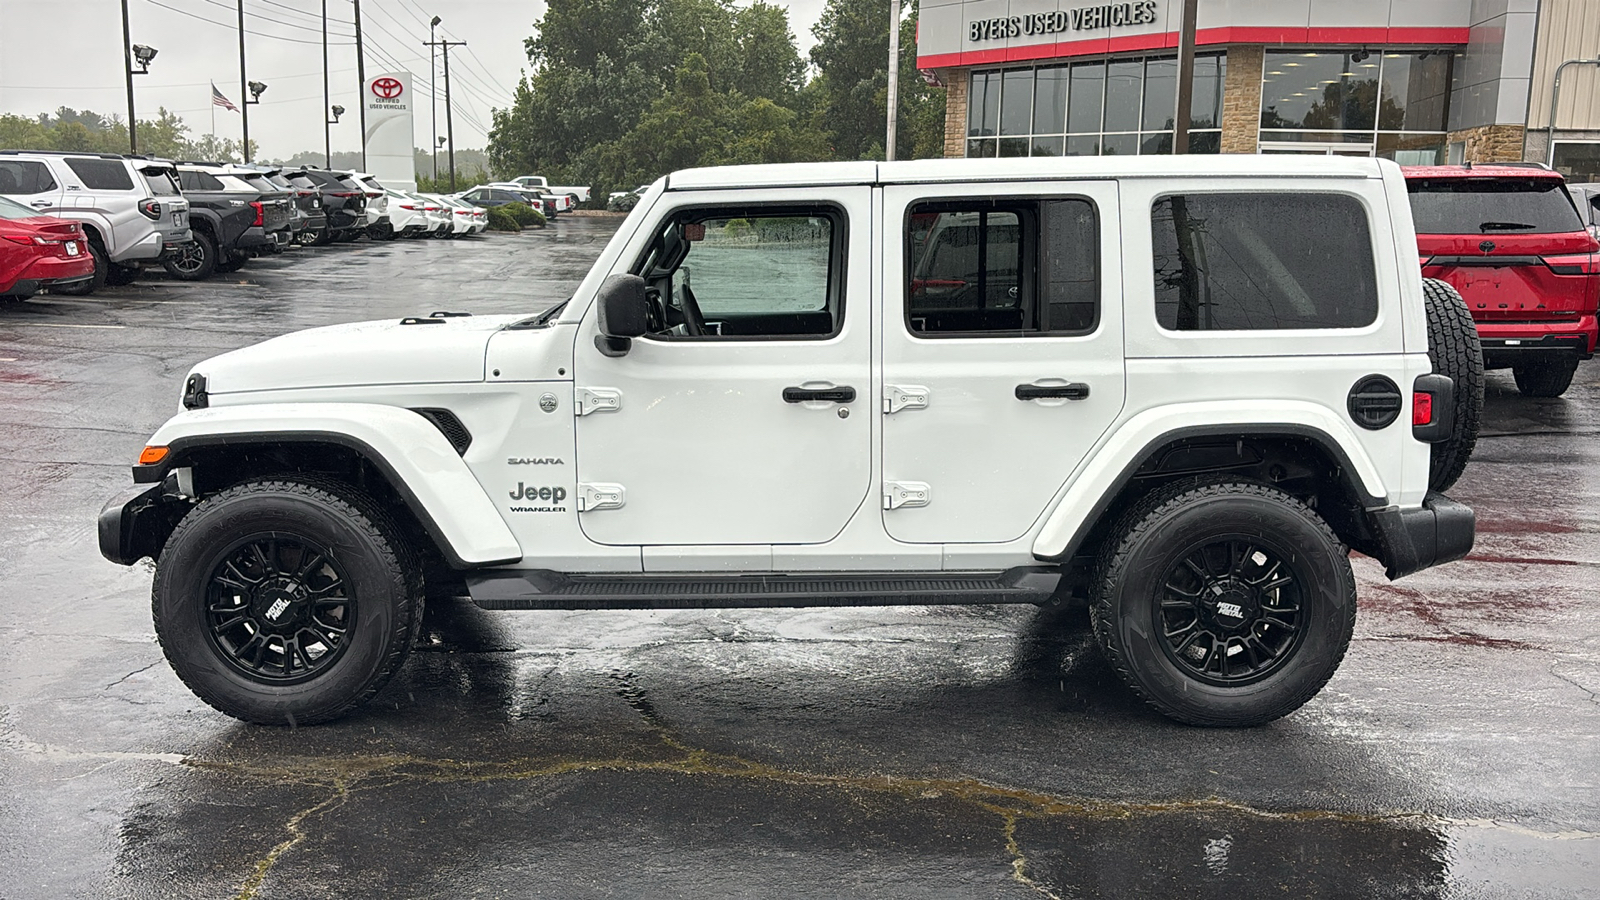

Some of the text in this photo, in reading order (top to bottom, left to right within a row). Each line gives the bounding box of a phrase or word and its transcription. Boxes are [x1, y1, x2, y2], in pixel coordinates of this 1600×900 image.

[969, 1, 1156, 41] BYERS USED VEHICLES
[509, 481, 567, 504] Jeep
[265, 597, 284, 620] MOTO
[270, 599, 291, 621] METAL
[1217, 601, 1242, 612] MOTO
[1218, 608, 1243, 619] METAL
